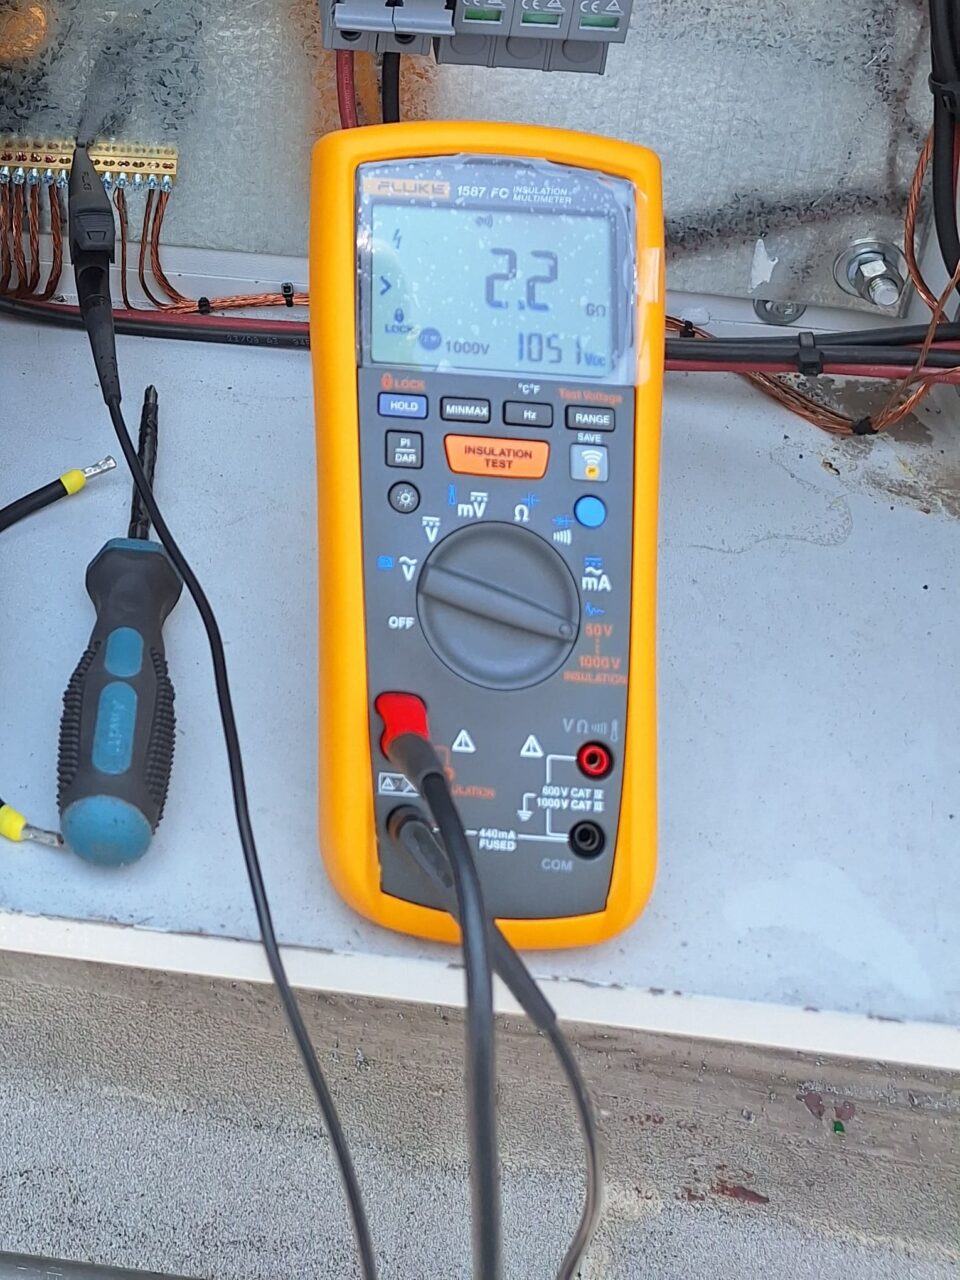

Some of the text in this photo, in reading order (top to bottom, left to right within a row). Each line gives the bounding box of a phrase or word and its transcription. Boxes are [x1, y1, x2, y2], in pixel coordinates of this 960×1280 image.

[377, 181, 509, 199] FLUKE 1587 FC
[513, 186, 568, 196] INSULATION
[513, 194, 572, 204] MULTIMETER
[485, 248, 558, 311] 2.2
[586, 303, 606, 317] GΩ
[385, 324, 413, 334] LOCK
[446, 340, 490, 355] 1000V
[518, 332, 581, 365] 1051
[394, 379, 426, 390] LOCK
[559, 389, 623, 404] Test Voltage
[390, 400, 418, 411] HOLD
[446, 405, 488, 417] MINMAX
[523, 410, 537, 420] Hz
[576, 414, 610, 425] RANGE
[400, 438, 411, 447] PI
[577, 433, 602, 443] SAVE
[464, 445, 533, 459] INSULATION
[395, 453, 416, 464] DAR
[484, 458, 513, 469] TEST
[457, 501, 486, 519] mV
[581, 575, 612, 592] mA
[388, 616, 415, 629] OFF
[451, 786, 495, 799] ULATION
[570, 788, 591, 799] CAT
[570, 799, 592, 810] CAT
[479, 829, 516, 840] 440mA
[479, 839, 517, 851] FUSED
[541, 858, 574, 871] COM
